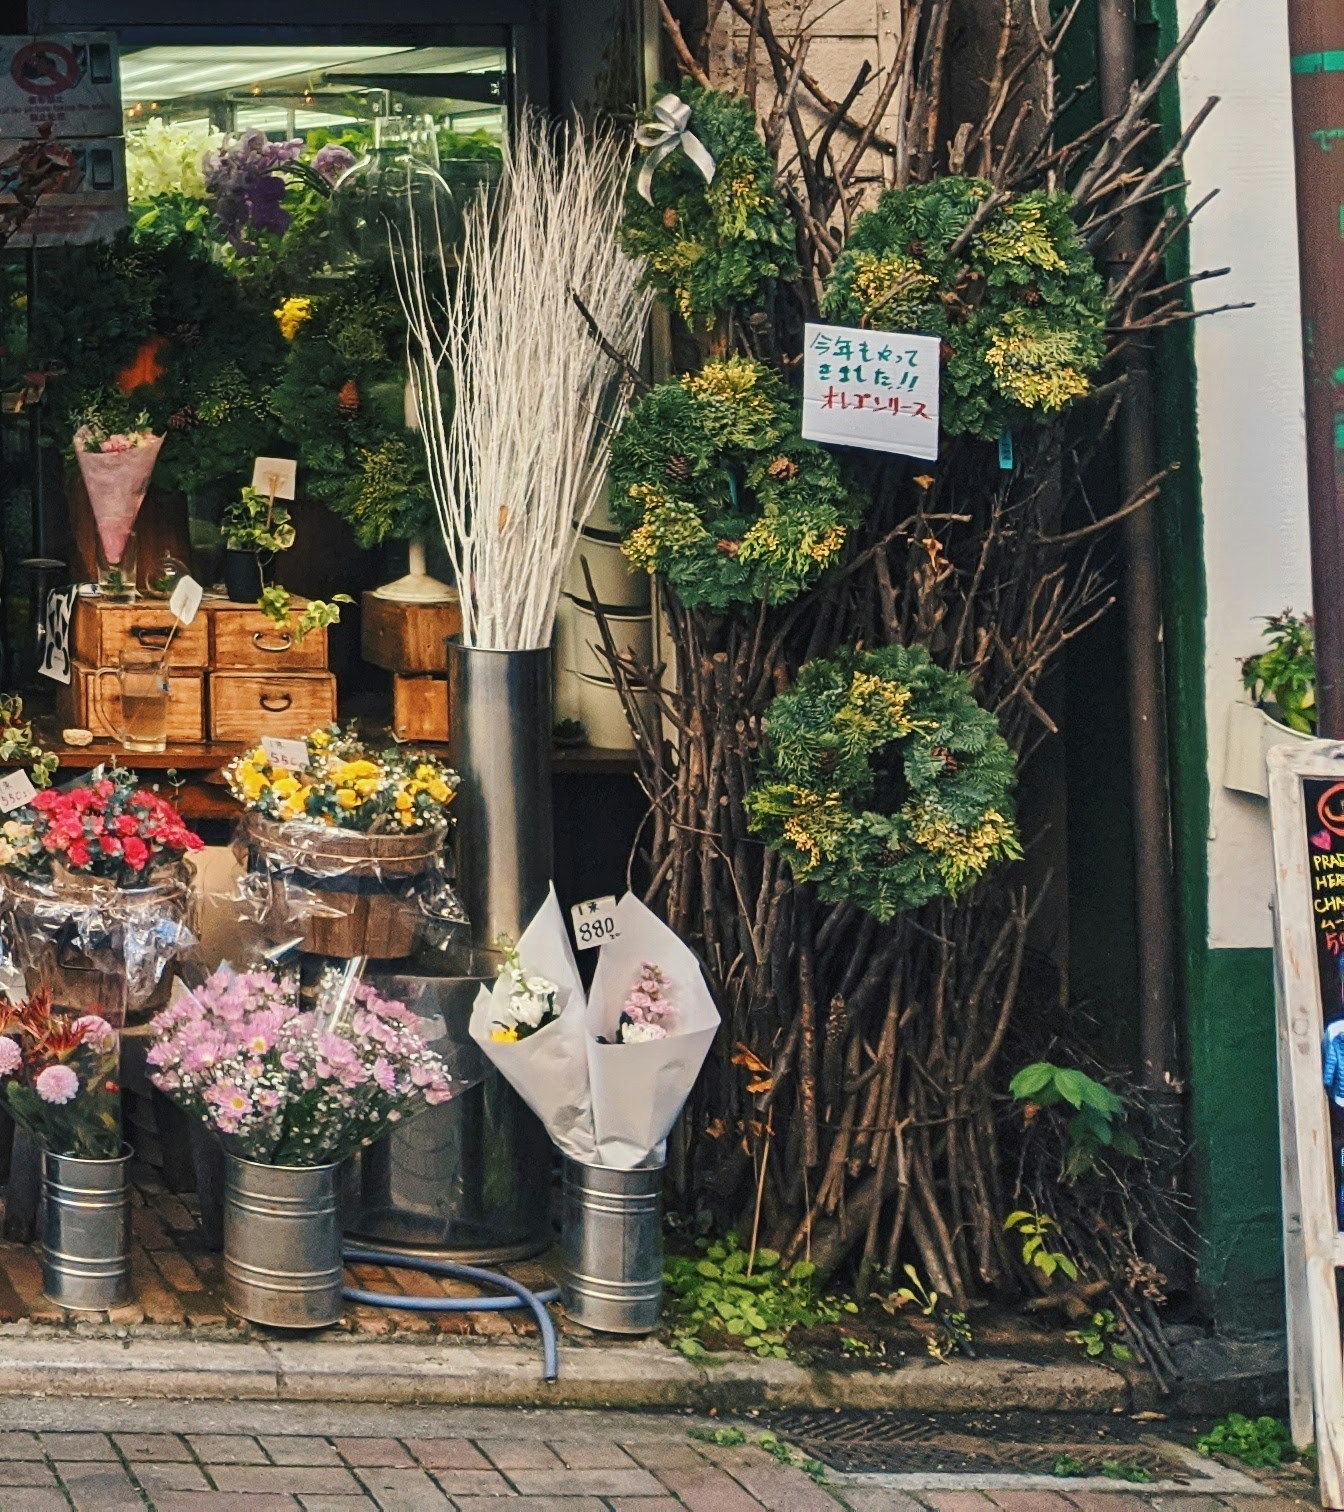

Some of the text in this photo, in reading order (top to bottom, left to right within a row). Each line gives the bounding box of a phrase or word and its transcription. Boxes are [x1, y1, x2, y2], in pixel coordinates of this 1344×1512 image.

[810, 332, 918, 367] 今年もやって
